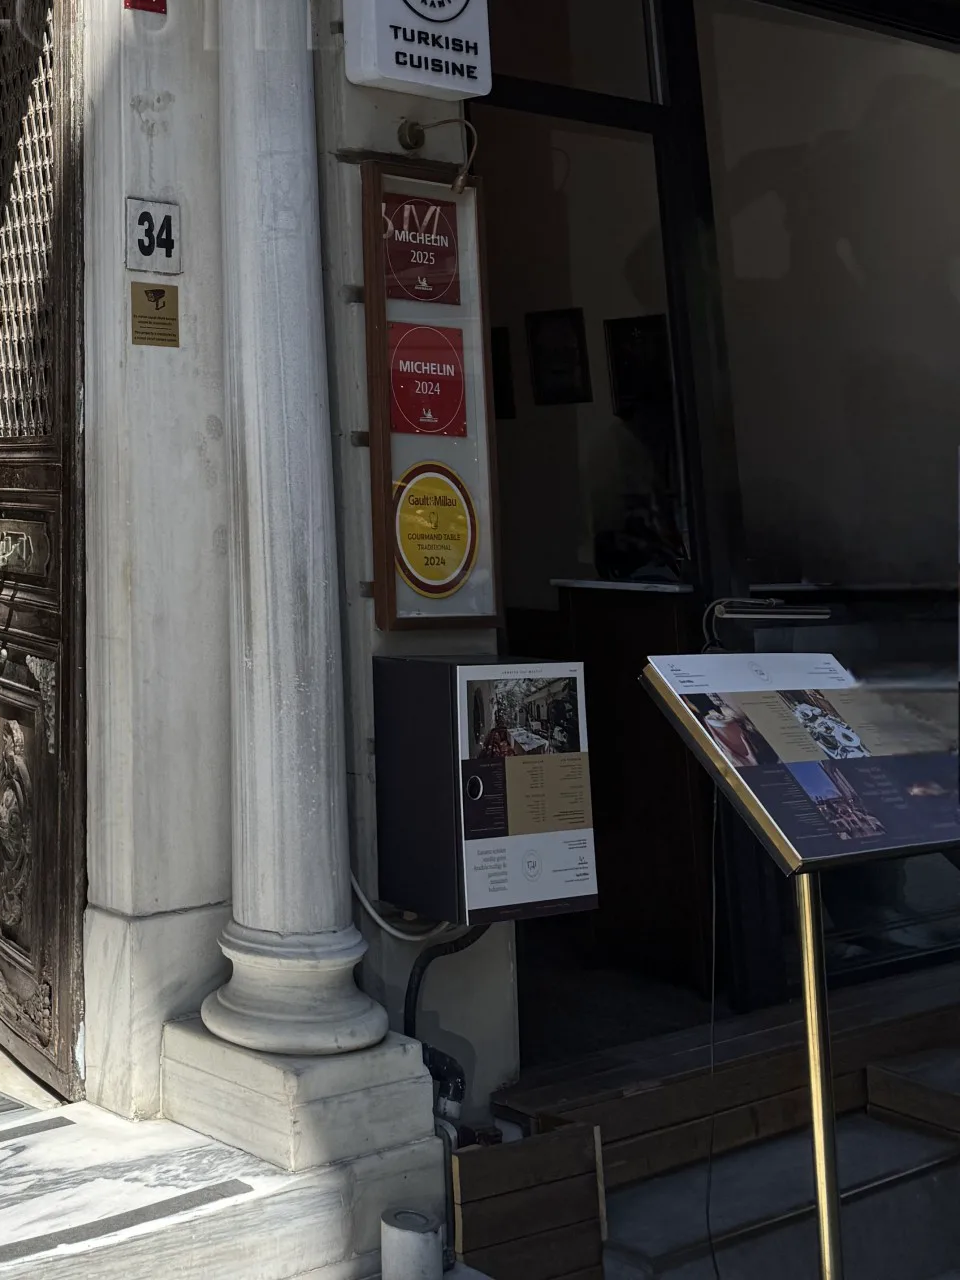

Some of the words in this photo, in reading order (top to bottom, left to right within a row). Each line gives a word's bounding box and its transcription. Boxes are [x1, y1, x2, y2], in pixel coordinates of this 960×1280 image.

[389, 24, 479, 56] TURKISH
[395, 51, 478, 80] CUISINE
[137, 211, 175, 258] 34
[394, 229, 449, 247] MICHELIN
[410, 249, 435, 265] 2025
[399, 359, 455, 376] MICHELIN
[415, 379, 441, 395] 2024
[407, 533, 442, 541] GOURMAND
[424, 556, 446, 567] 2024
